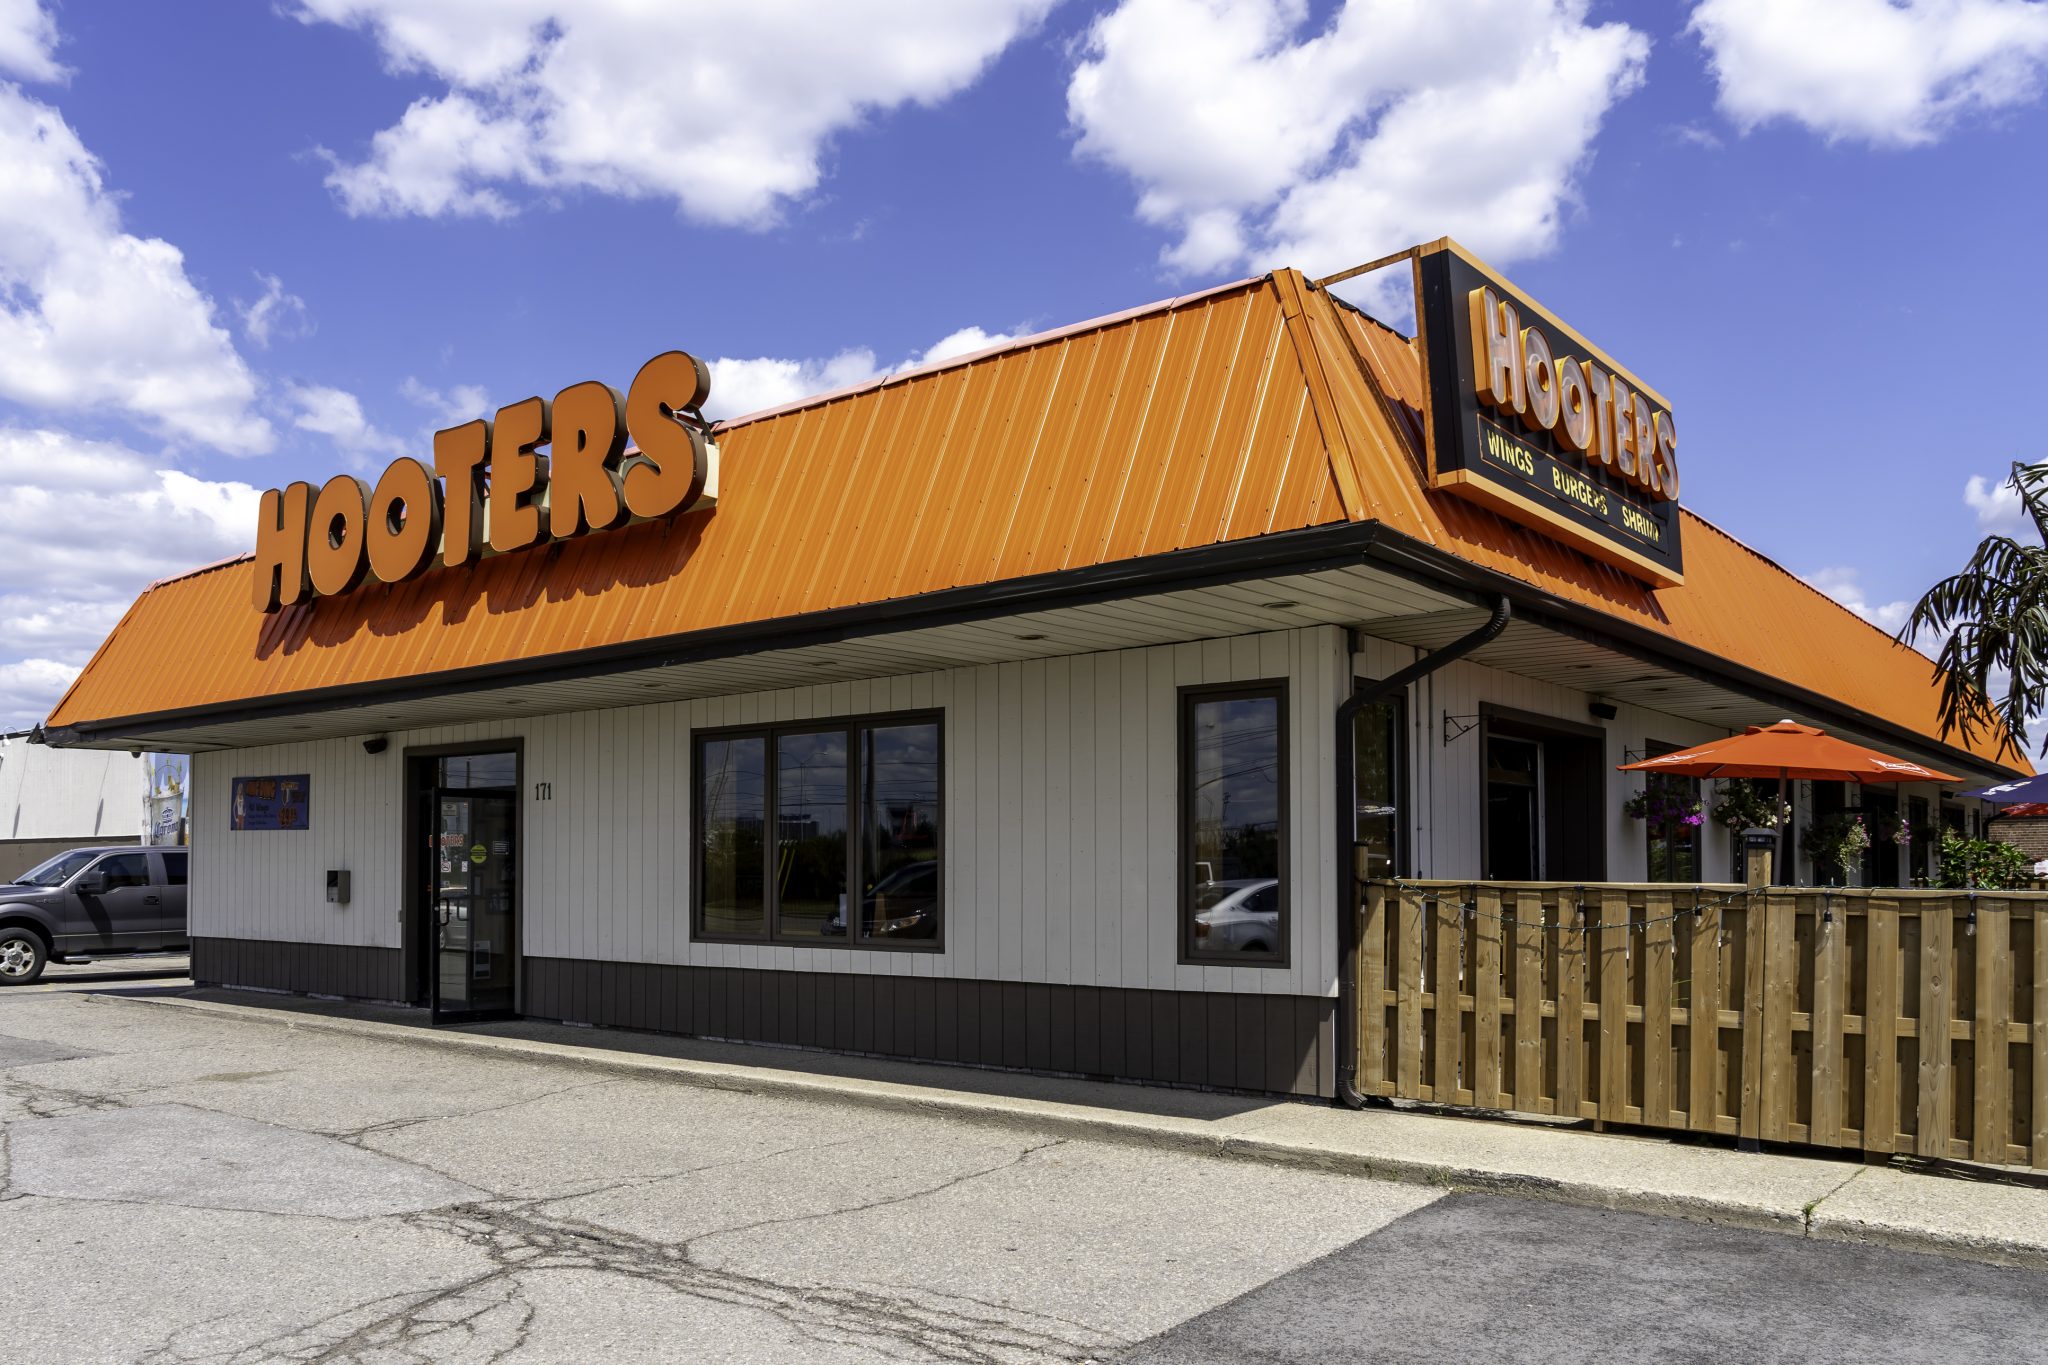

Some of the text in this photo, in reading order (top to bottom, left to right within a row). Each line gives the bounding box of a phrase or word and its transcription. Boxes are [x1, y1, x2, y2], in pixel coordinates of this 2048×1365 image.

[1469, 285, 1679, 501] HOOTERS
[1486, 429, 1534, 476] WINGS
[252, 350, 711, 614] HOOTERS
[535, 782, 551, 801] 171
